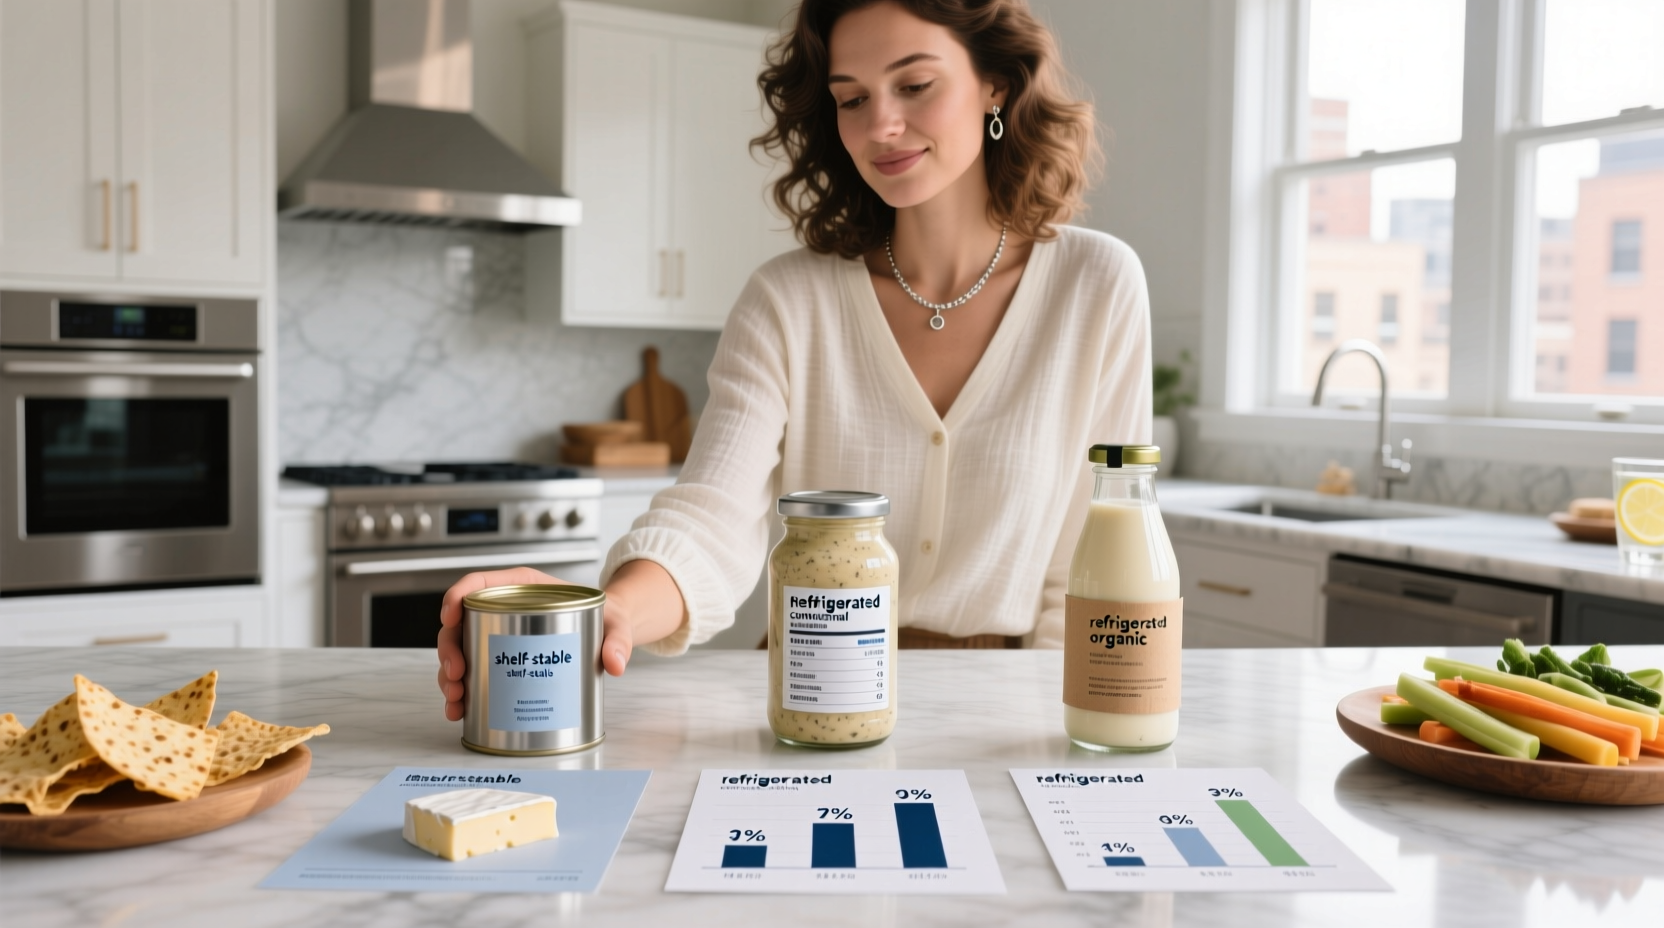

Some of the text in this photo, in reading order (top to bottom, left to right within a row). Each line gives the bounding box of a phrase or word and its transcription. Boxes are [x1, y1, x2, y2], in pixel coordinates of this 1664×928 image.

[1089, 631, 1147, 649] organic
[495, 650, 572, 665] shelf stable
[817, 807, 853, 819] 7%
